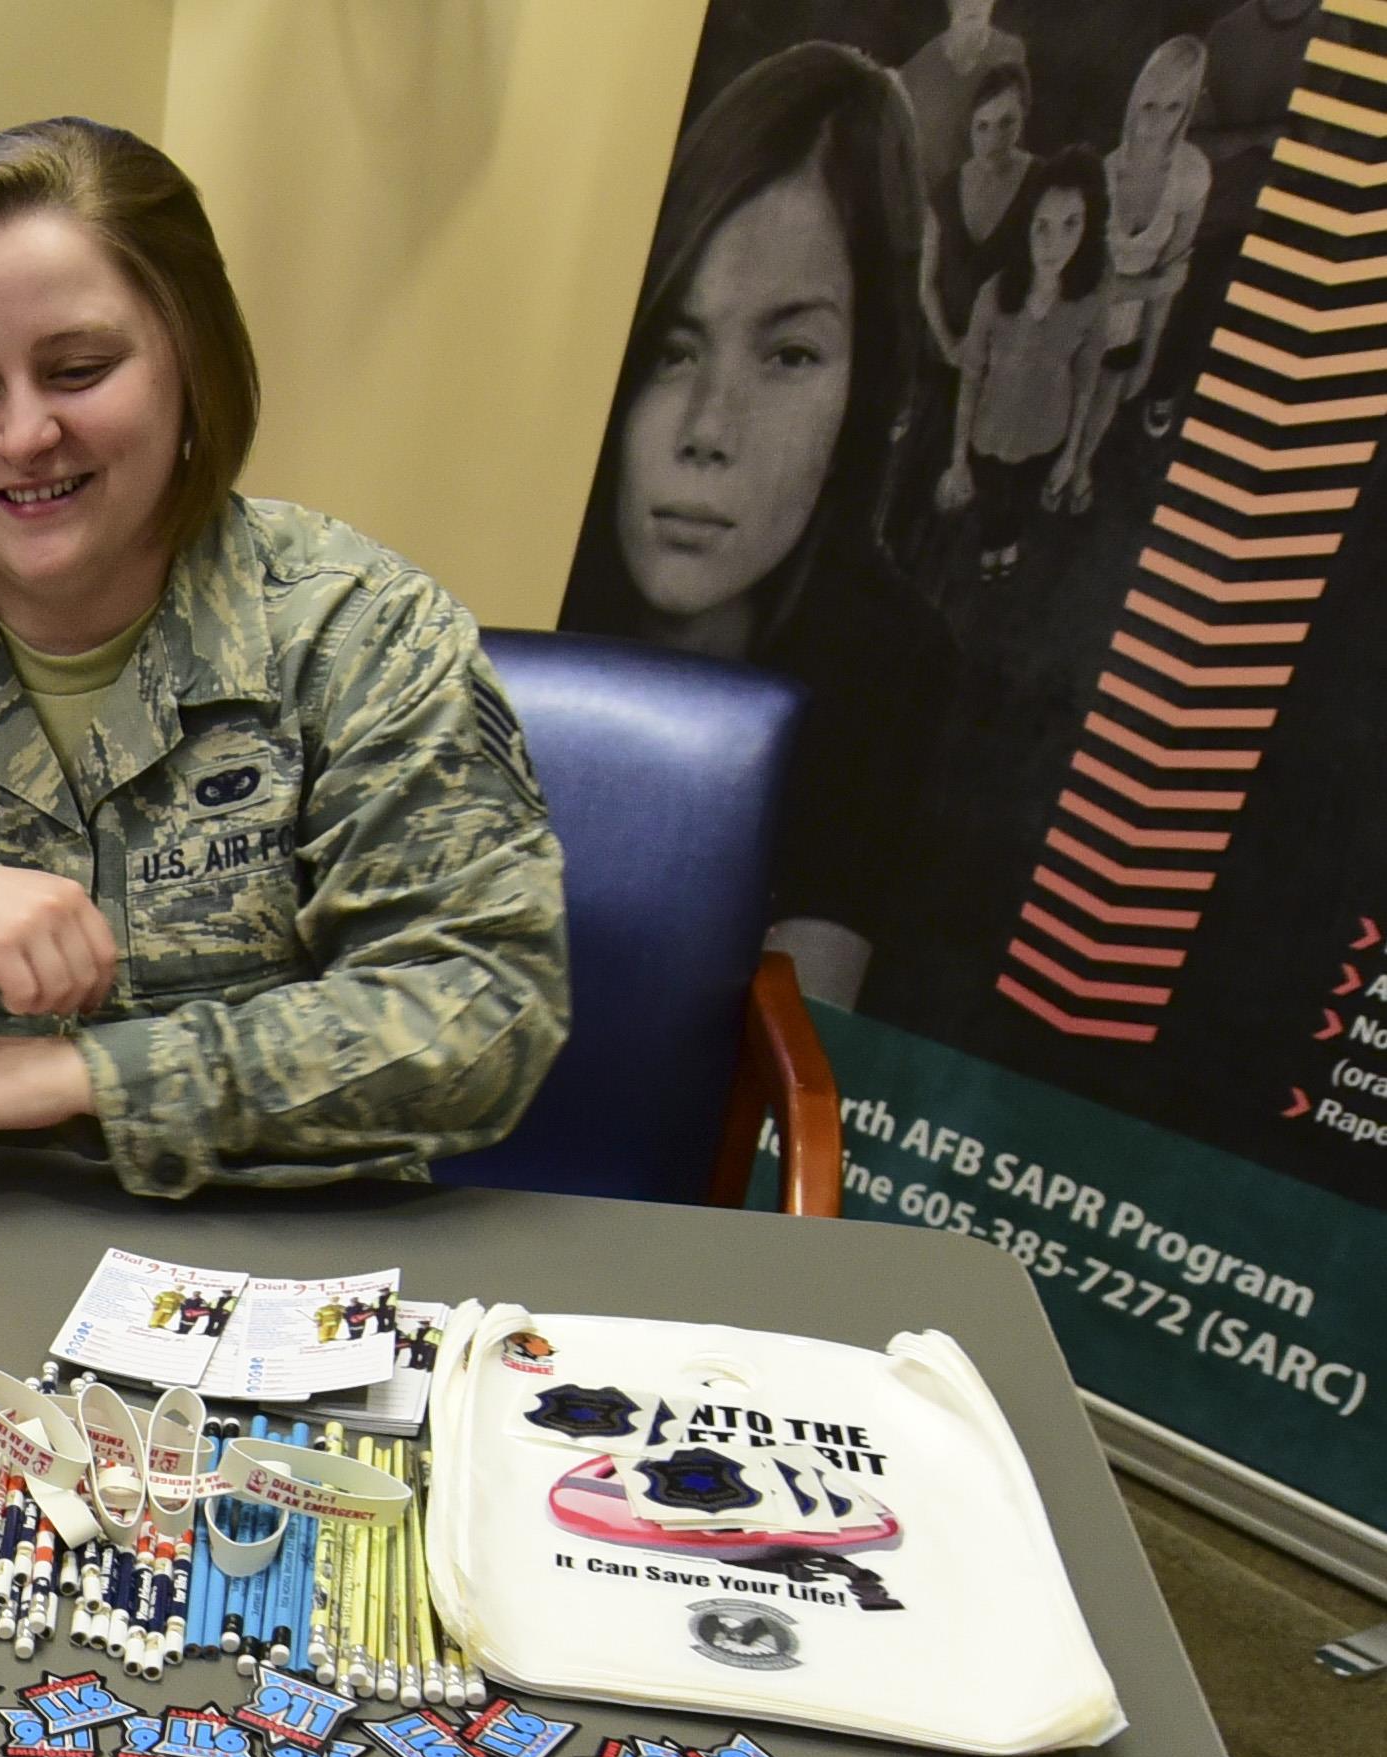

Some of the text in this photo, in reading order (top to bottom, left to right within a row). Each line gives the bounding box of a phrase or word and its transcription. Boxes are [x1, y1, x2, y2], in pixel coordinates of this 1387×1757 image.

[143, 847, 195, 884] U.S.
[203, 836, 250, 874] AIR
[1349, 1014, 1387, 1050] No
[1331, 1057, 1387, 1099] (ora
[900, 1117, 987, 1180] AFB
[987, 1153, 1106, 1229] SAPR
[1109, 1199, 1316, 1319] Program
[111, 1250, 197, 1282] Dial 9-1-1
[254, 1281, 346, 1296] Dial 9-1-1
[899, 1182, 1194, 1337] 605-385-7272
[1197, 1309, 1368, 1417] (SARC)
[690, 1403, 773, 1435] NTO
[782, 1418, 871, 1449] THE
[266, 1490, 377, 1521] IN AN EMERGENCY
[271, 1478, 336, 1504] DIAL 9-1-1
[555, 1553, 847, 1608] It Can Save Your Life!
[36, 1684, 112, 1721] 911
[257, 1686, 339, 1736] 911
[168, 1719, 247, 1753] 911
[477, 1710, 546, 1757] 911
